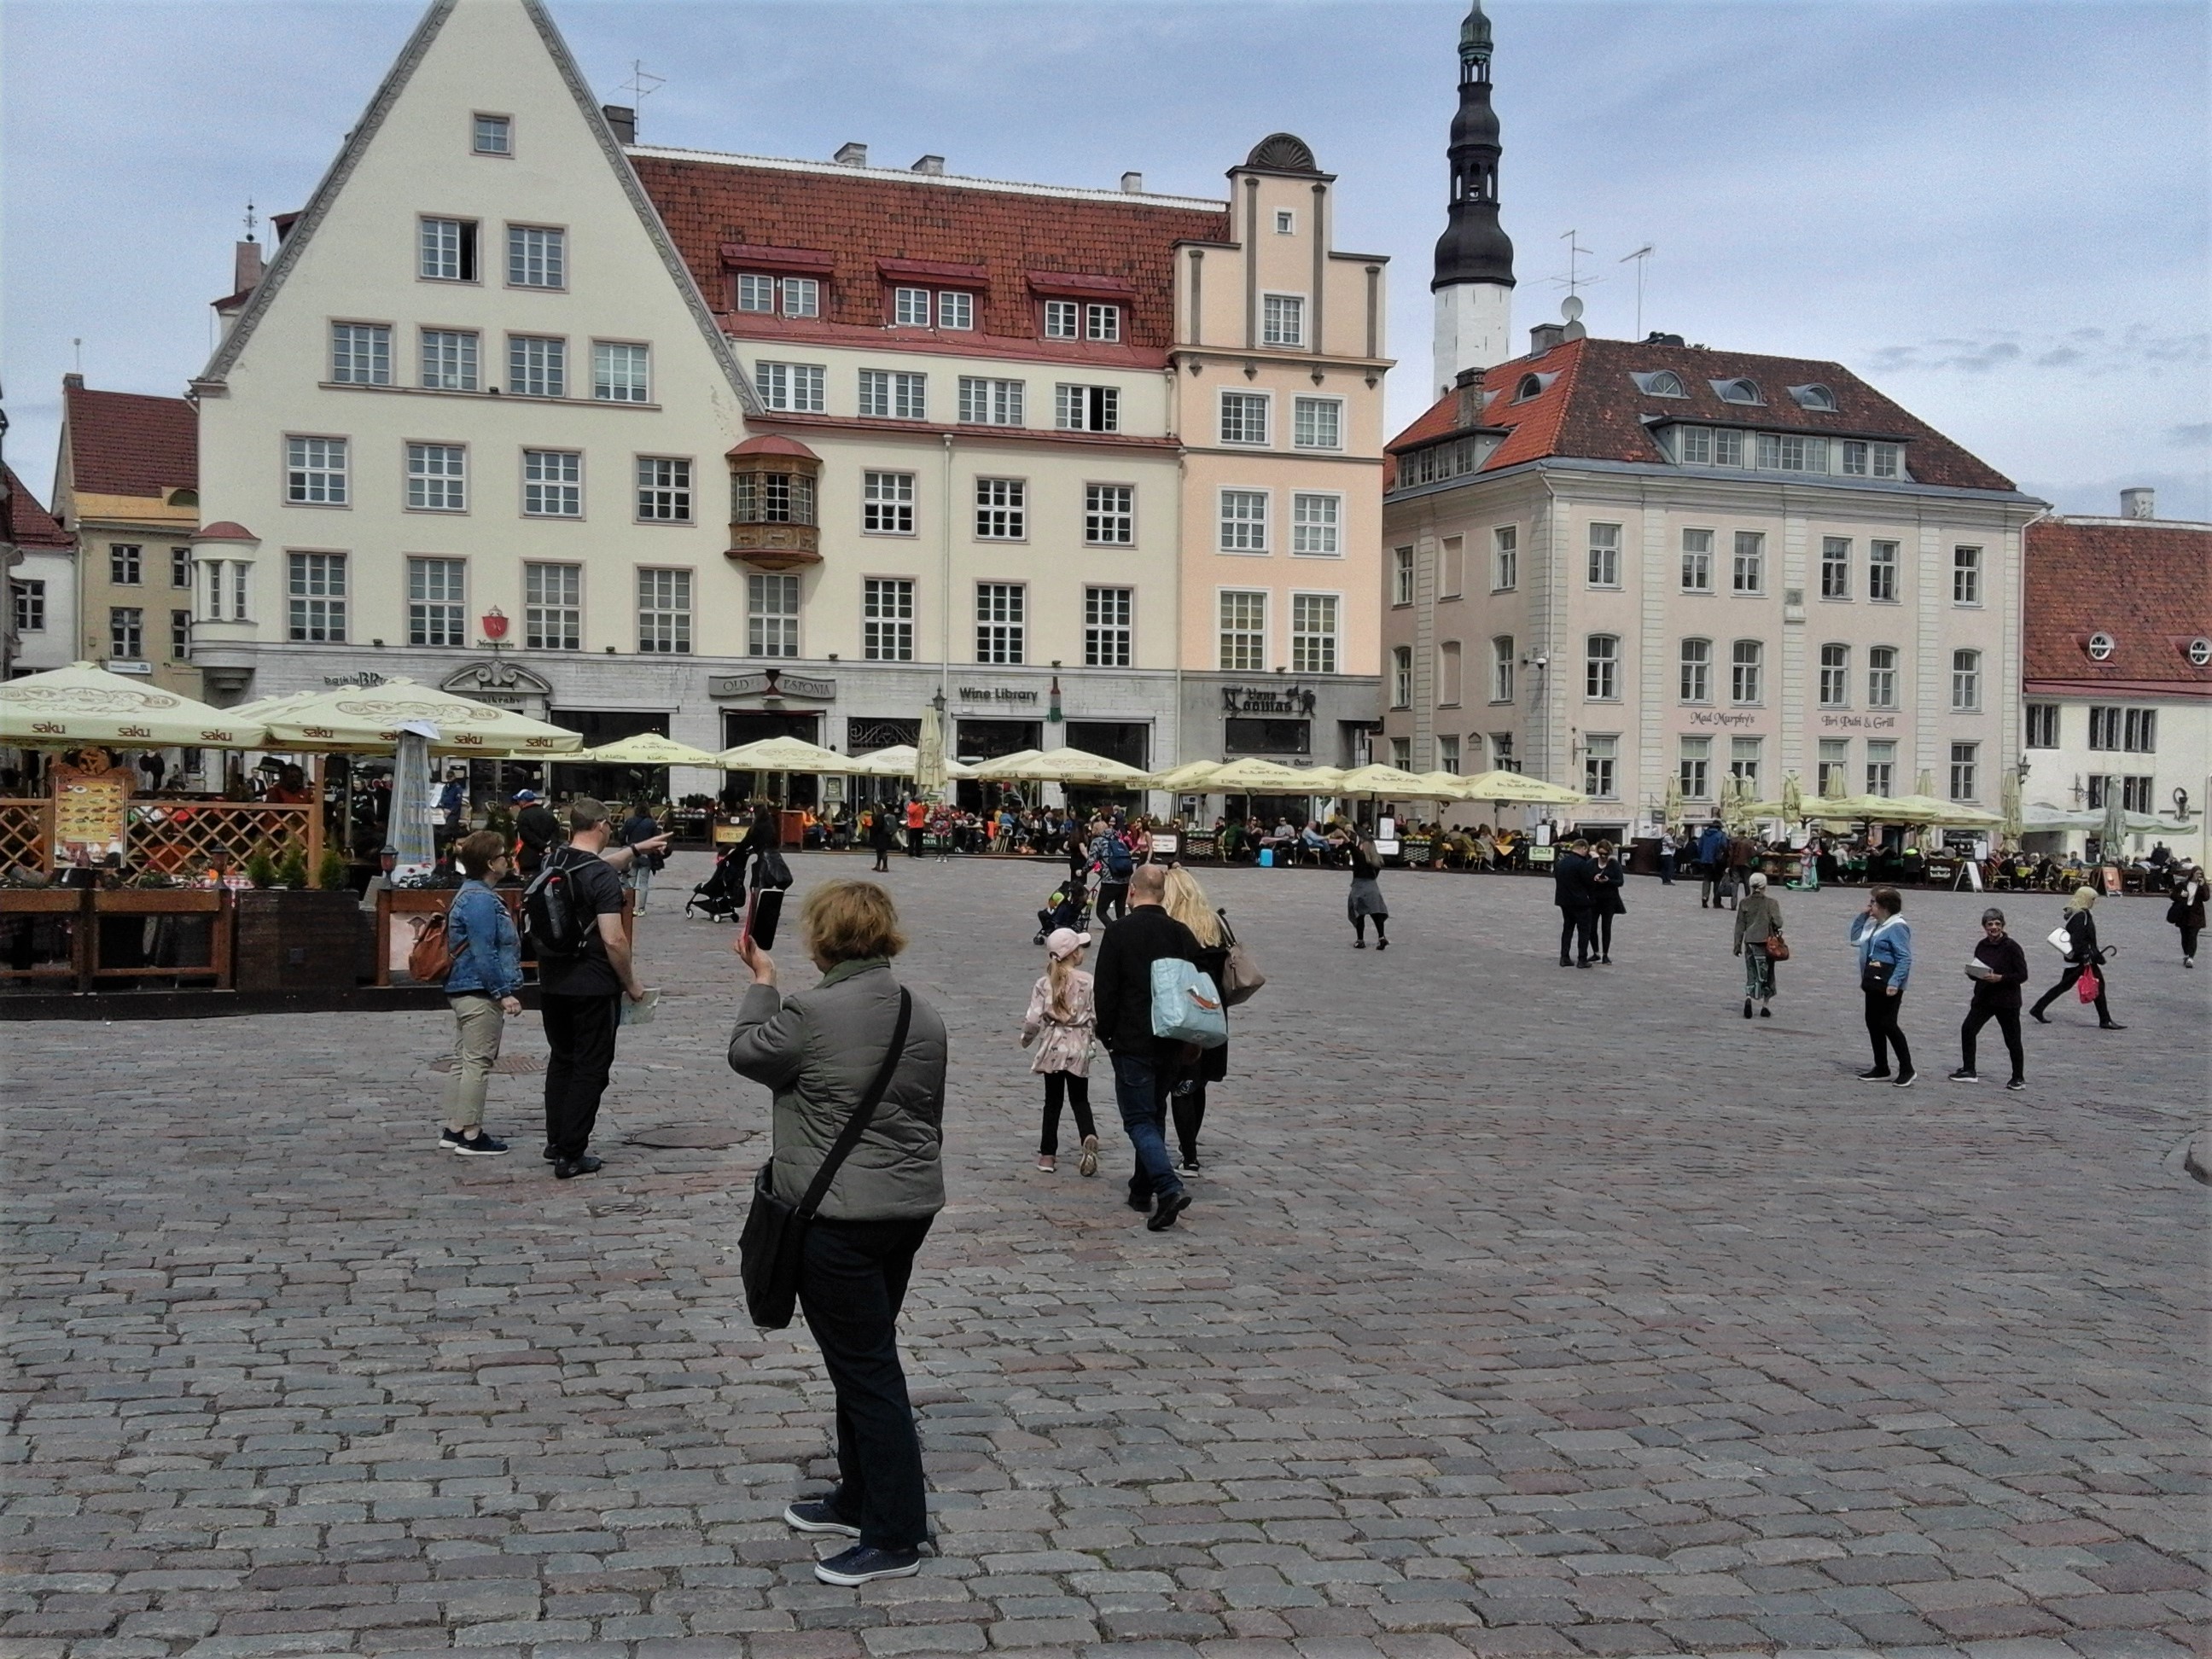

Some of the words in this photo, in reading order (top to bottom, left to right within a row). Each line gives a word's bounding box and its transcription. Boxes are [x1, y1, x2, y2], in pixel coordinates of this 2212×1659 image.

[723, 679, 749, 692] OLD
[783, 678, 830, 696] ESTONIA
[959, 687, 991, 699] Wine
[994, 687, 1038, 706] Library
[1690, 712, 1713, 725] Mad
[1713, 712, 1755, 727] Murphy's
[1872, 717, 1895, 729] Grill
[32, 722, 66, 735] saku
[118, 725, 151, 738] saku
[302, 727, 334, 739] saku
[201, 729, 233, 742] saku
[379, 730, 400, 742] sak
[454, 733, 483, 745] saku
[526, 736, 554, 748] saku
